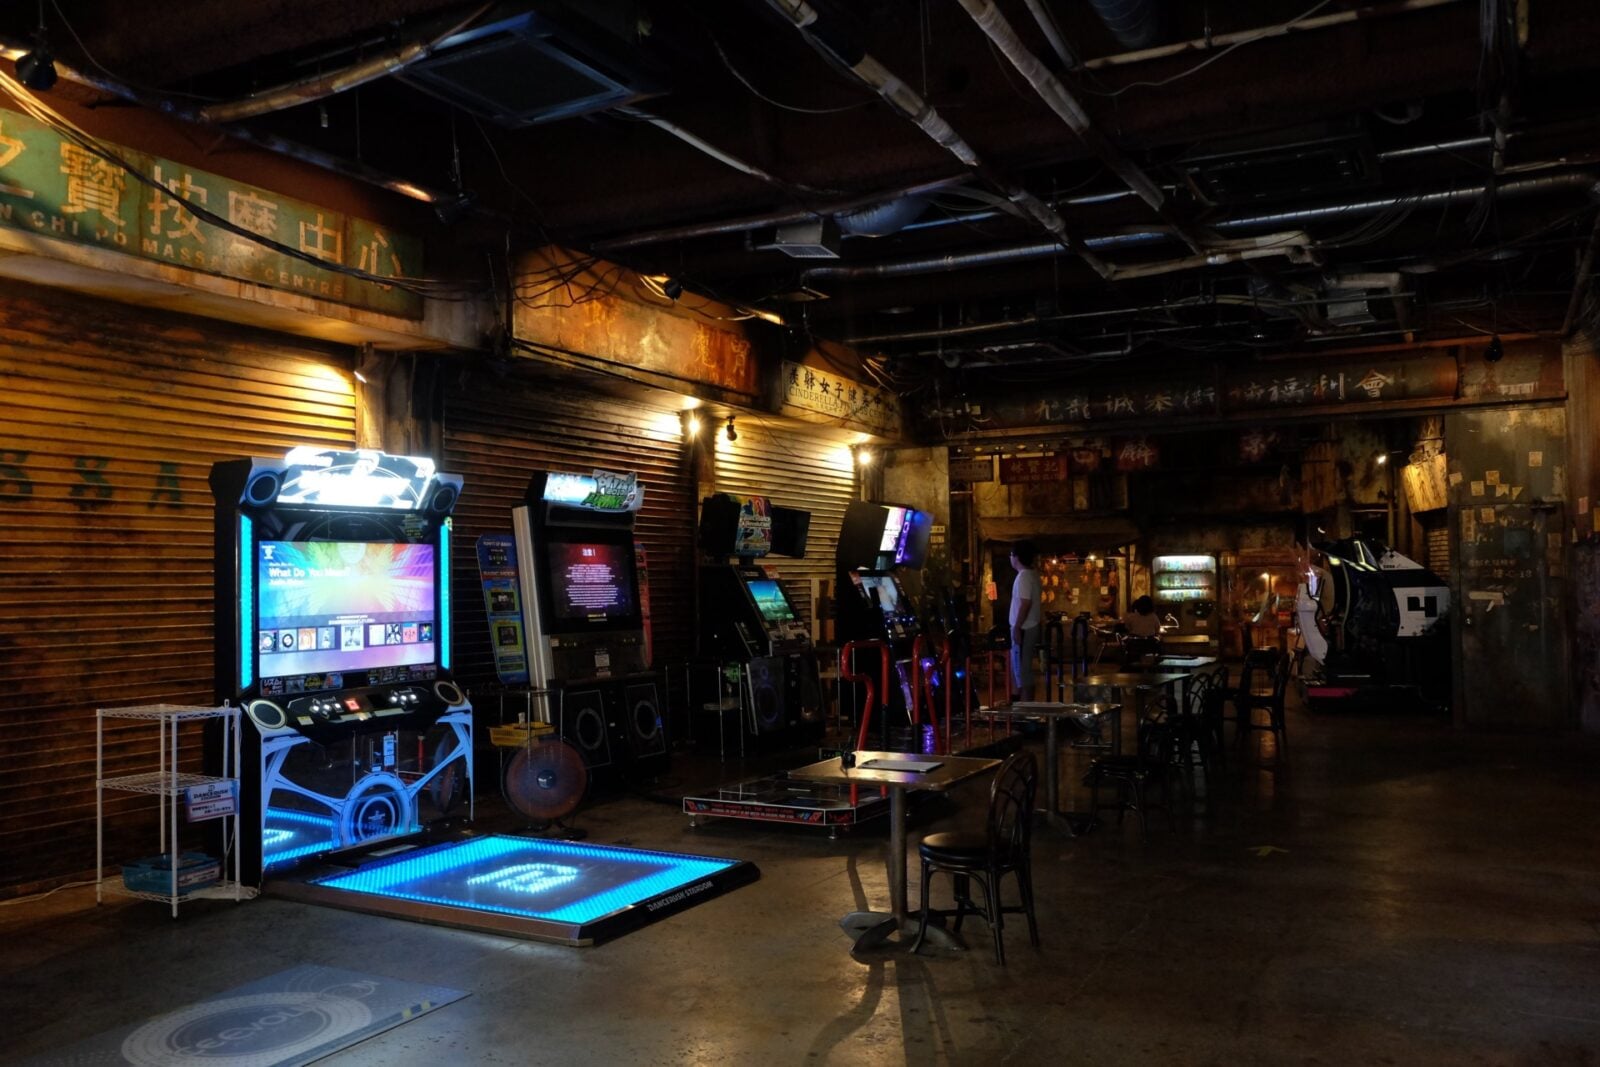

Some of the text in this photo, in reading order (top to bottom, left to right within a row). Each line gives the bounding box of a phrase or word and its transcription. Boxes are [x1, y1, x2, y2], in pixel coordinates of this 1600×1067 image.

[31, 210, 80, 236] CHI
[95, 224, 128, 246] PO
[265, 267, 345, 298] CENTRE
[268, 567, 291, 577] What
[293, 567, 305, 577] Do
